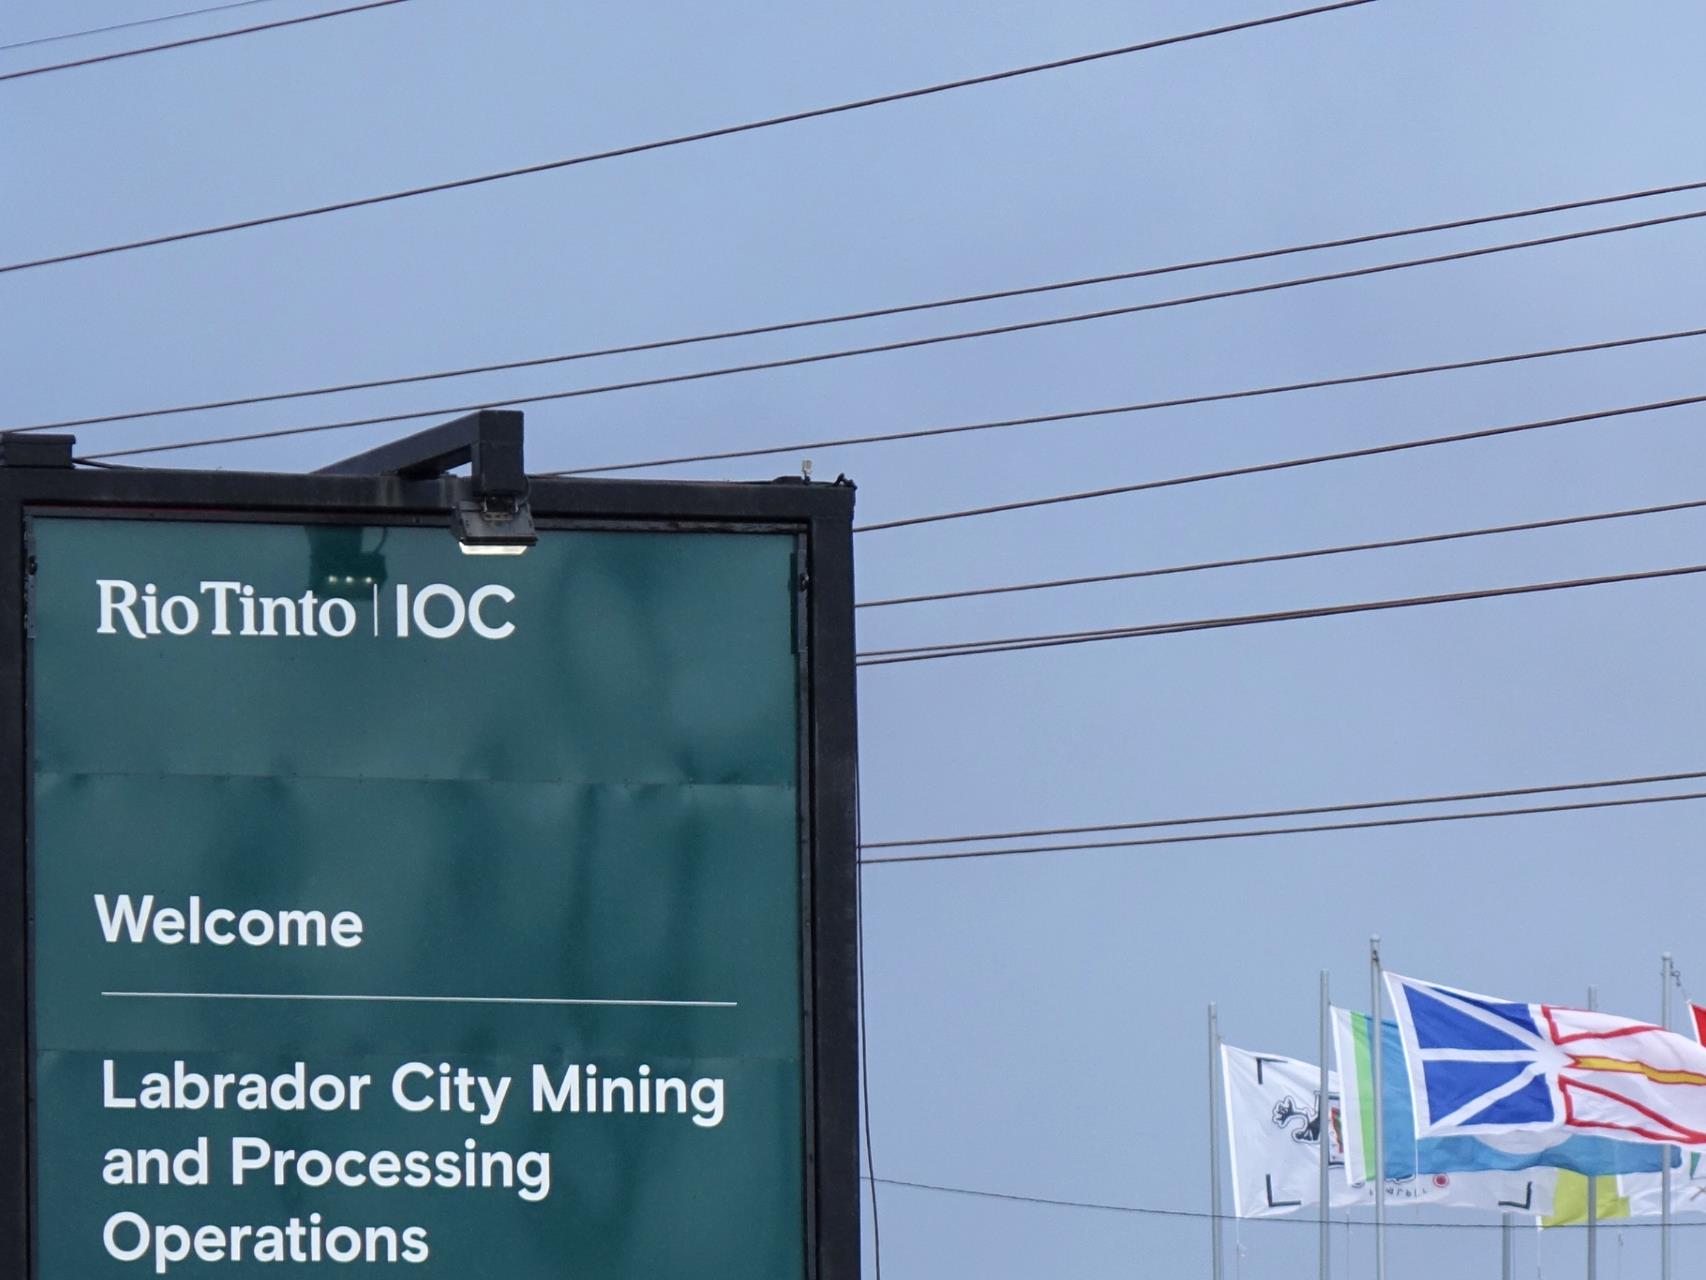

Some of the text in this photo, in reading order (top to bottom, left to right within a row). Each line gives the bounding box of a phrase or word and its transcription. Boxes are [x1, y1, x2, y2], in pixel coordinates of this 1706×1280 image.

[397, 583, 516, 639] IOC
[94, 894, 363, 947] Welcome
[103, 1060, 726, 1127] Labrador City Mining
[102, 1136, 551, 1201] and Processing
[103, 1211, 429, 1274] Operations
